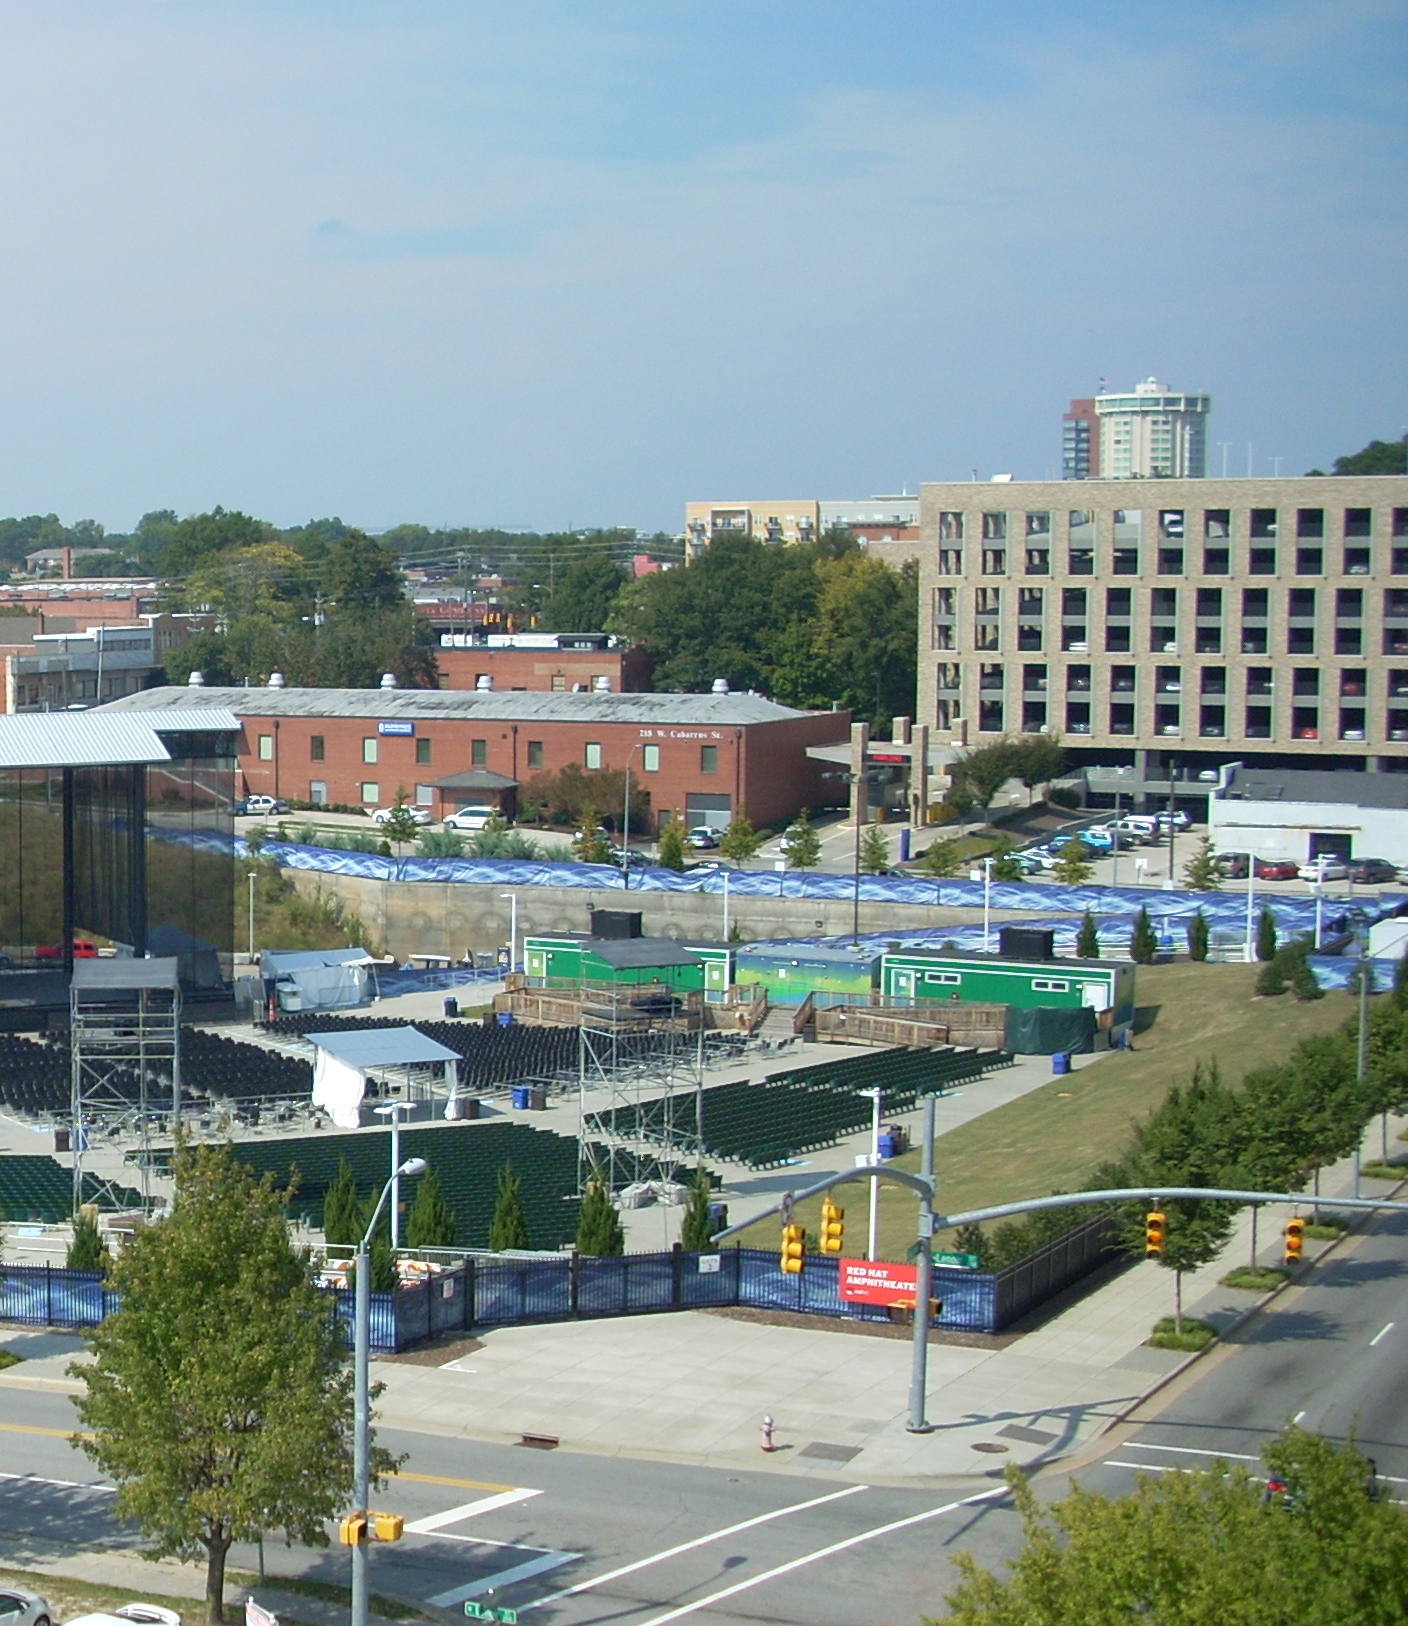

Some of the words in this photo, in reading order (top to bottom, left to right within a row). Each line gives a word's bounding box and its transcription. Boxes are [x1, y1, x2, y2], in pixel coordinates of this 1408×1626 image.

[670, 730, 708, 739] Cabarrus
[846, 1266, 867, 1277] RED
[867, 1268, 889, 1278] HAT
[846, 1275, 917, 1292] AMPHITHEATE
